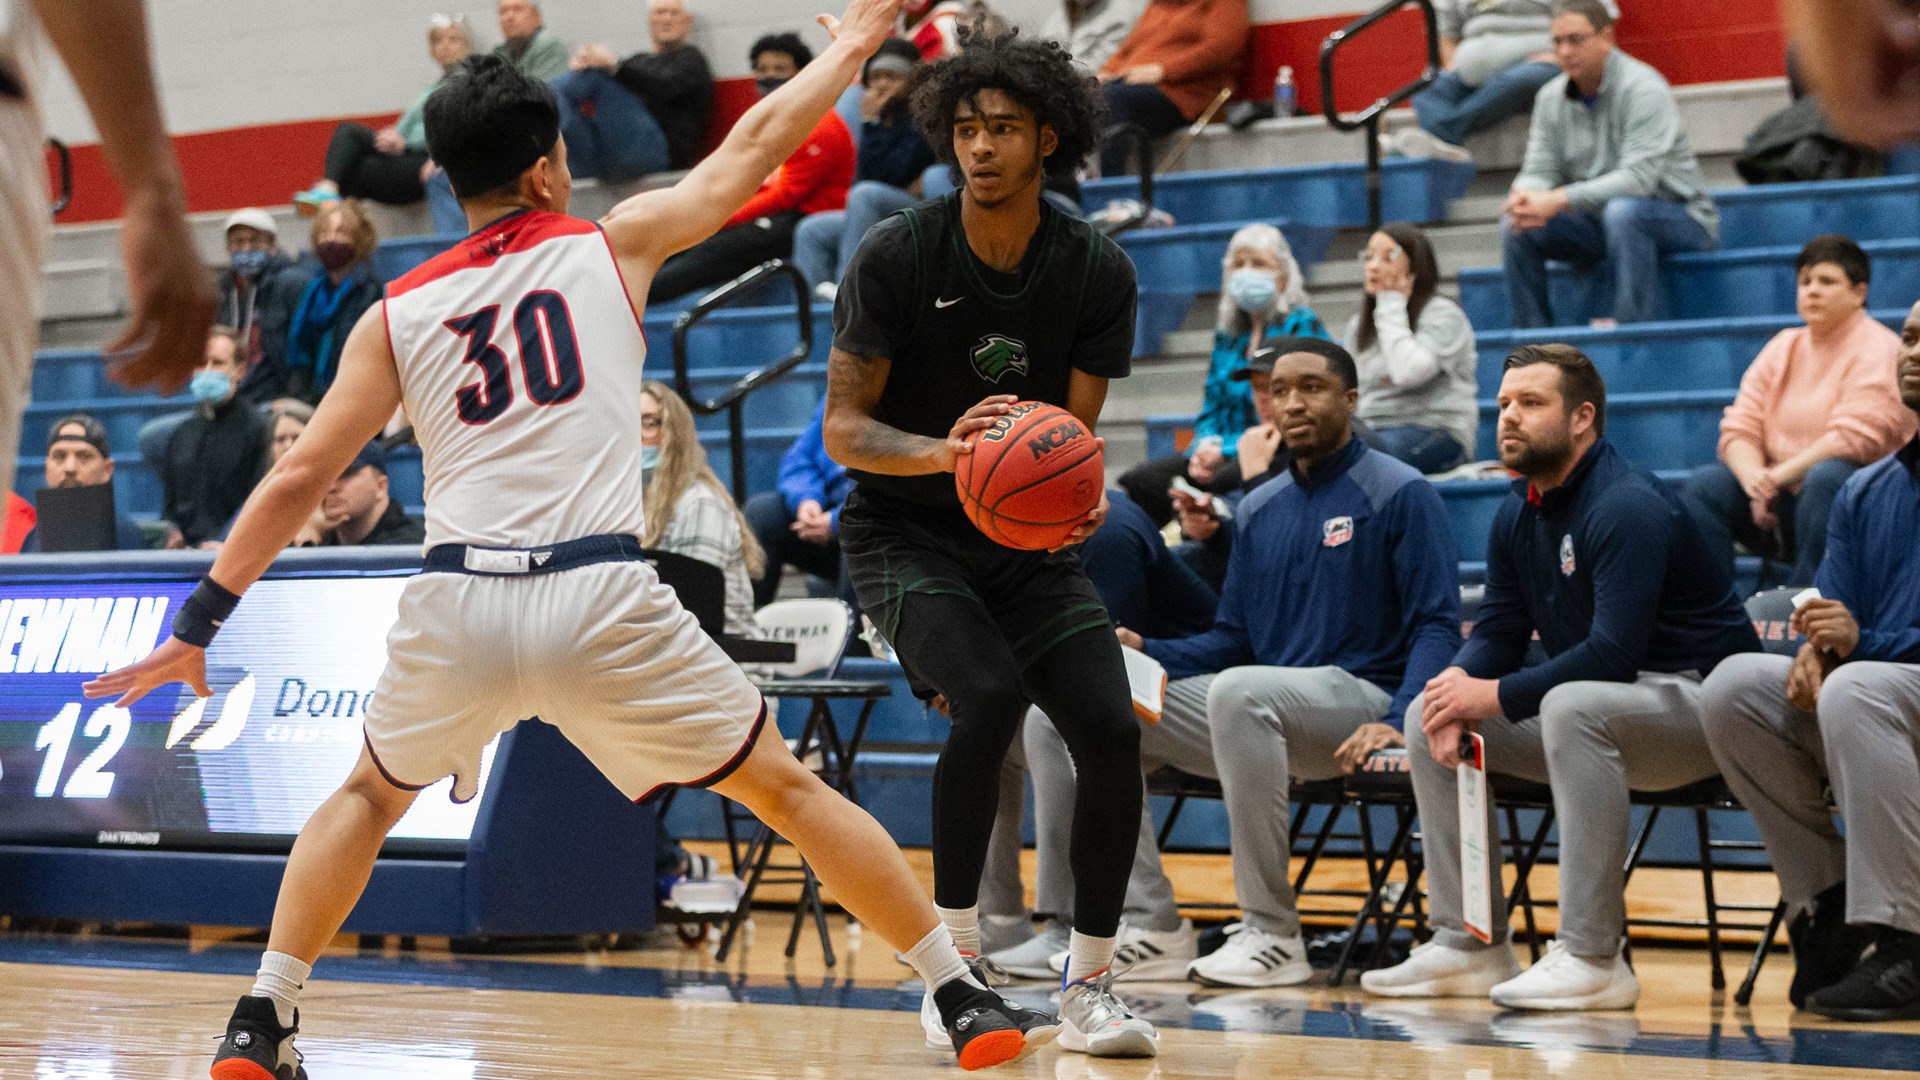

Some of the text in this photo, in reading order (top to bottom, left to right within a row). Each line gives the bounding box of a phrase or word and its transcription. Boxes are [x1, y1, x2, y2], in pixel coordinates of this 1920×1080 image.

[443, 289, 586, 426] 30
[1028, 420, 1085, 461] NCAA
[0, 597, 169, 674] EWMAN
[34, 702, 132, 798] 12
[1362, 756, 1411, 773] JETS
